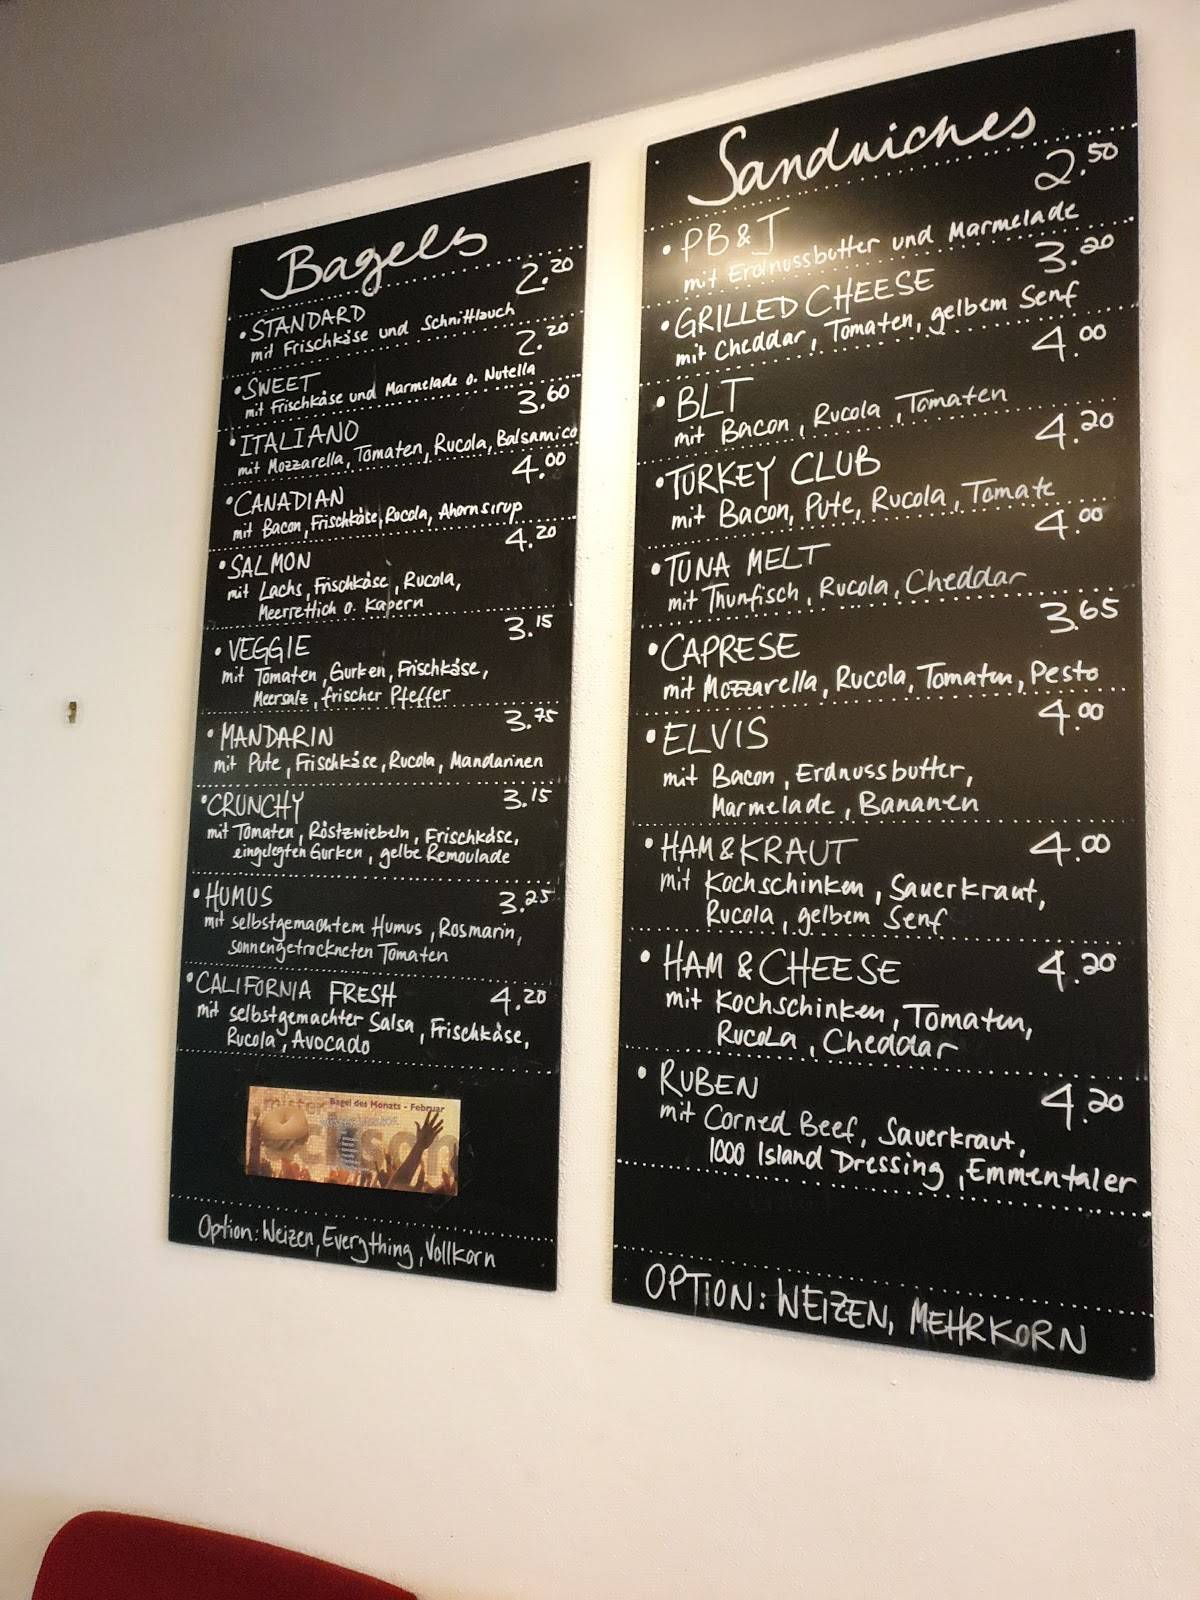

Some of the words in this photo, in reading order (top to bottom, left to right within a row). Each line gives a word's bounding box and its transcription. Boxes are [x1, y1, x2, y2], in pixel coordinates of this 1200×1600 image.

[687, 106, 1036, 206] Sandwiches
[260, 224, 489, 300] Bagels
[684, 270, 716, 293] mit
[728, 234, 881, 283] Erdnussbutter
[893, 224, 934, 251] und
[949, 200, 1079, 242] Marmelade
[250, 305, 368, 341] STANDARD
[675, 296, 801, 342] GRILLED
[806, 268, 935, 317] CHEESE
[676, 345, 706, 367] mit
[929, 297, 1007, 335] gelbem
[1019, 280, 1079, 309] Senf
[251, 343, 273, 363] mit
[379, 320, 409, 339] und
[421, 302, 515, 331] Schnittlauch
[242, 372, 323, 402] SWEET
[245, 402, 264, 419] mit
[349, 381, 377, 403] und
[385, 373, 457, 397] Marmelade
[466, 373, 478, 385] o.
[485, 362, 535, 381] Nutella
[677, 374, 754, 422] BLT
[240, 420, 361, 459] ITALIANO
[674, 425, 705, 447] mit
[814, 400, 881, 430] Rucola
[238, 461, 260, 476] mit
[497, 426, 577, 447] Balsamico
[665, 456, 776, 501] TURKEY
[791, 445, 881, 485] CLUB
[234, 486, 344, 517] CANADIAN
[671, 504, 706, 530] mit
[961, 476, 1055, 507] Tomate
[233, 522, 253, 541] mit
[227, 552, 311, 579] SALMON
[664, 551, 730, 589] TUNA
[747, 543, 831, 576] MELT
[227, 584, 249, 601] mit
[668, 589, 698, 612] mit
[906, 565, 1030, 597] Cheddar
[258, 600, 336, 621] Meerrettich
[343, 603, 357, 615] o.
[365, 595, 423, 619] Kapern
[229, 635, 311, 665] VEGGIE
[661, 632, 800, 671] CAPRESE
[222, 666, 244, 684] mit
[663, 676, 695, 700] mit
[1031, 660, 1098, 685] Pesto
[321, 686, 382, 703] frischer
[391, 685, 451, 710] Pfeffer
[221, 722, 333, 751] MANDARIN
[663, 716, 768, 755] ELVIS
[214, 755, 237, 773] mit
[450, 751, 543, 769] Mandarinen
[663, 764, 698, 787] mit
[207, 790, 305, 824] CRUNCHY
[859, 791, 979, 816] Bananen
[207, 822, 229, 839] mit
[233, 841, 306, 868] eingelegten
[379, 841, 422, 869] gelbe
[426, 843, 510, 864] Remoulade
[205, 880, 272, 912] HUMUS
[660, 866, 690, 892] mit
[204, 910, 225, 929] mit
[230, 912, 365, 942] selbstgemachtem
[798, 905, 870, 936] gelbem
[883, 905, 948, 935] Senf
[228, 937, 373, 963] sonnengetrockneten
[377, 942, 448, 965] Tomaten
[663, 940, 723, 981] HAM
[759, 947, 901, 988] CHEESE
[196, 971, 311, 1001] CALIFORNIA
[330, 981, 397, 1008] FRESH
[666, 988, 702, 1010] mit
[197, 1001, 219, 1018] mit
[228, 1004, 364, 1038] selbstgemachter
[291, 1029, 370, 1055] Avocado
[823, 1025, 959, 1062] Cheddar
[661, 1059, 758, 1099] RUBEN
[660, 1101, 696, 1123] mit
[704, 1104, 791, 1136] Corned
[759, 1141, 823, 1170] Island
[830, 1149, 944, 1194] Dressing
[198, 1214, 259, 1244] Option:
[426, 1233, 495, 1267] Vollkorn
[646, 1263, 766, 1311] OPTION:
[910, 1295, 1086, 1354] MEHRKORN
